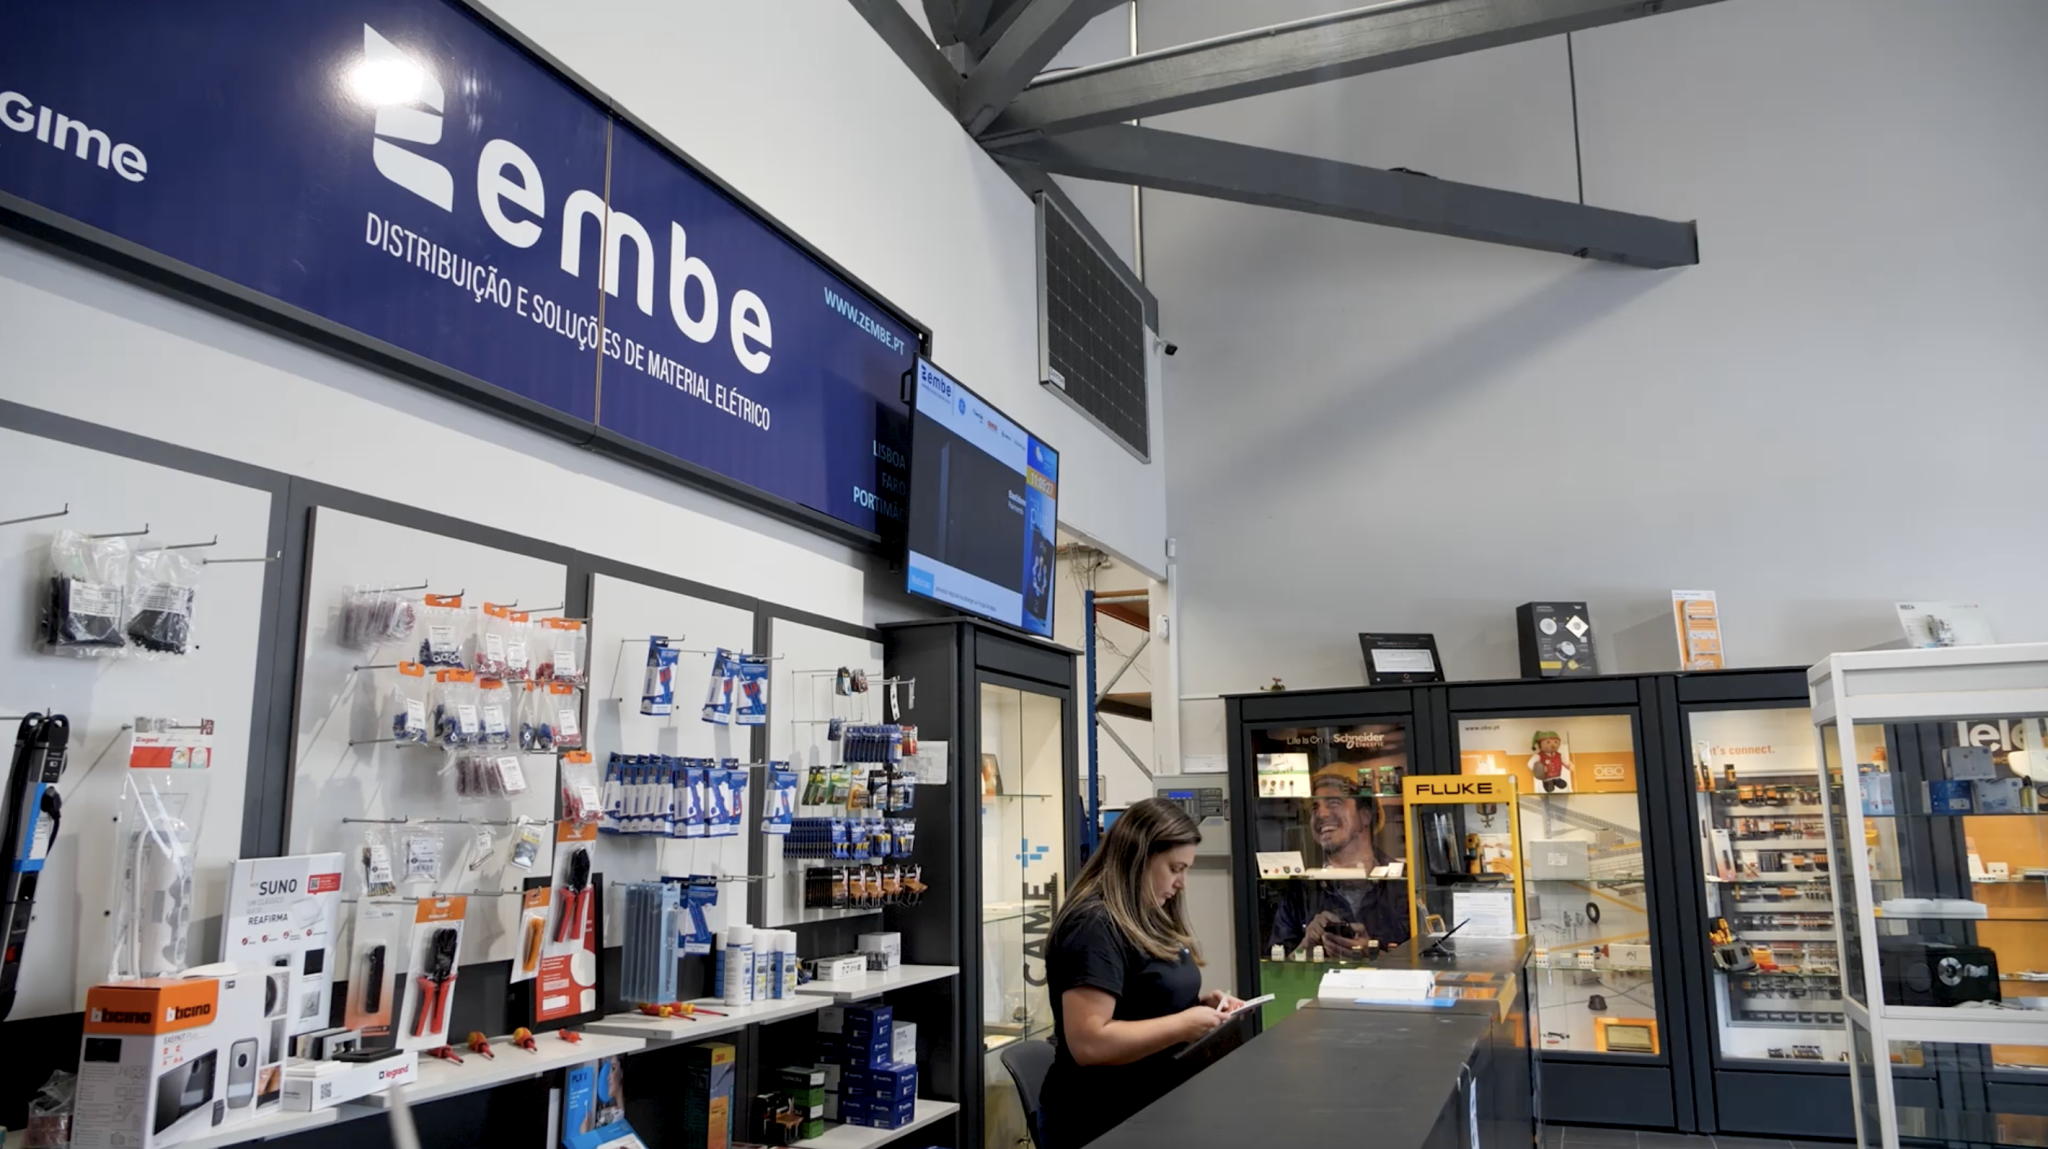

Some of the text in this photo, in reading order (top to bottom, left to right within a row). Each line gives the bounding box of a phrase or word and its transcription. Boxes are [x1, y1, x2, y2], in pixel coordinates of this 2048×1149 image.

[366, 212, 770, 431] DISTRIBUIÇÃO E SOLUÇÕES DE MATERIAL ELÉTRICO
[824, 286, 905, 356] WWW.ZEMBE.PT
[872, 439, 907, 471] LISBOA
[881, 471, 907, 497] FARO
[1333, 732, 1385, 749] Schneider
[1728, 744, 1775, 755] connect.
[1594, 766, 1624, 776] OBO
[1416, 783, 1493, 795] FLUKE
[259, 878, 298, 896] SUNO
[248, 913, 288, 926] REAFIRMA
[1022, 882, 1051, 987] CAME
[166, 1003, 211, 1022] bticino
[386, 1063, 410, 1079] legrand
